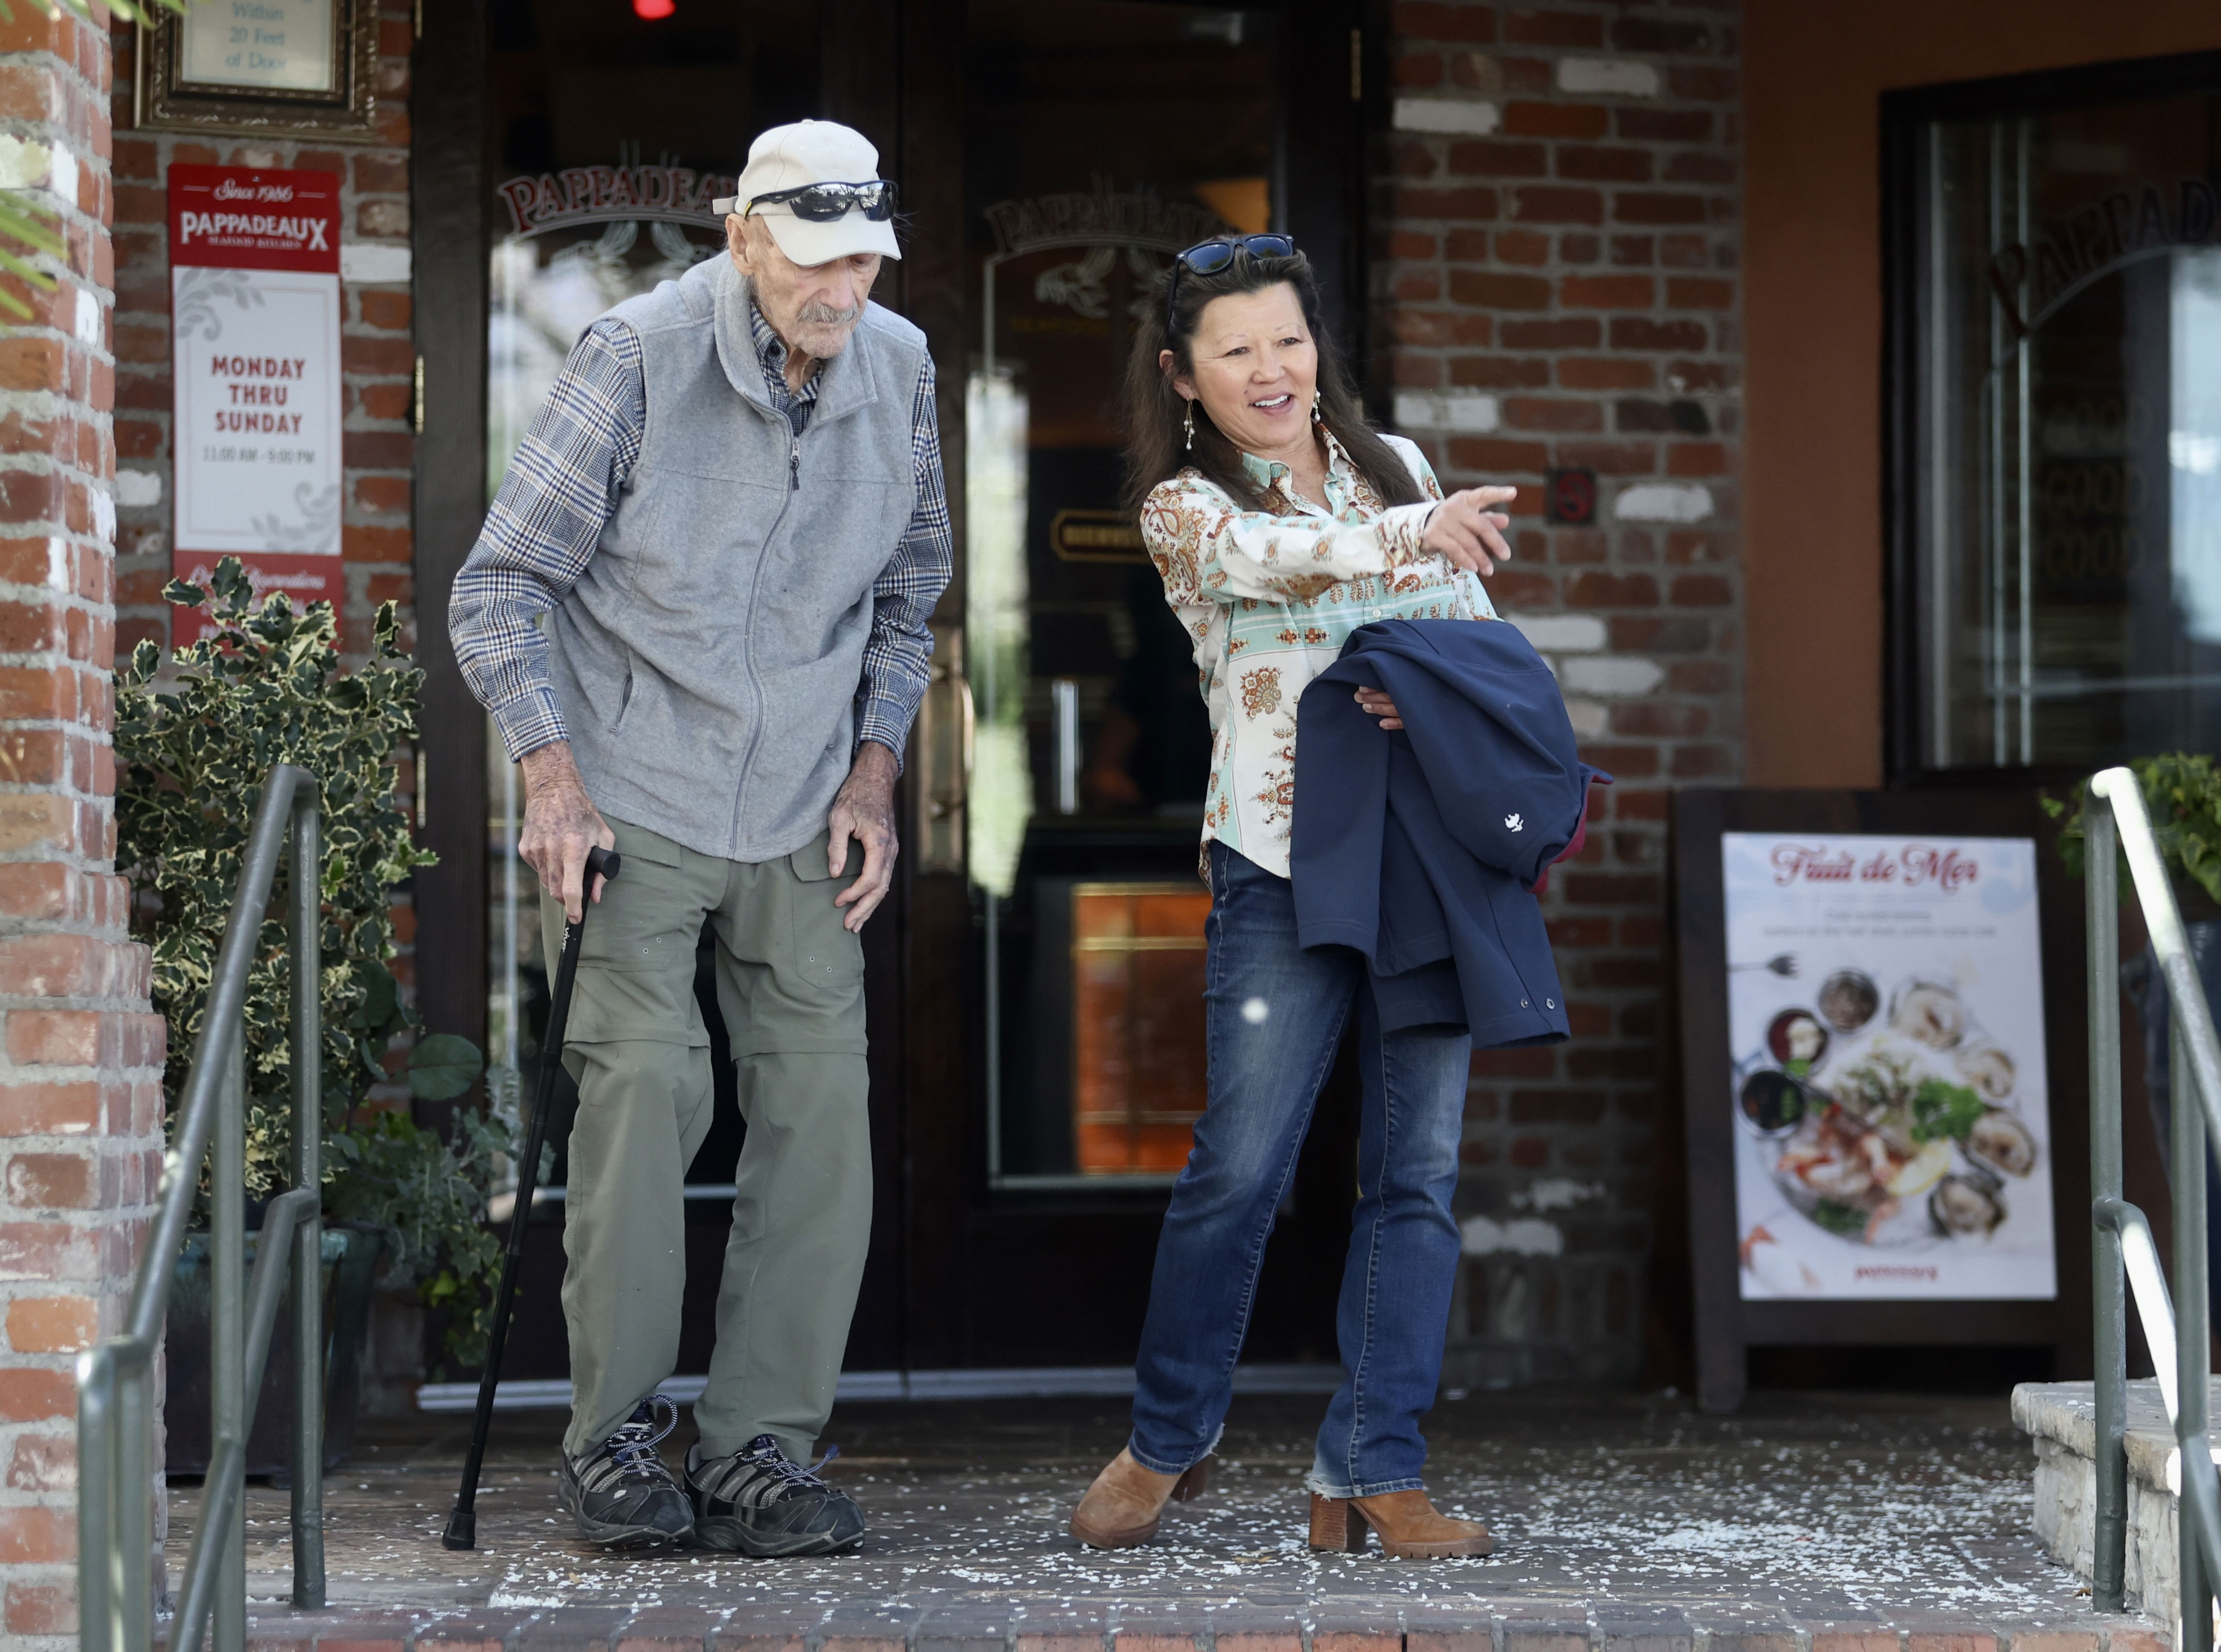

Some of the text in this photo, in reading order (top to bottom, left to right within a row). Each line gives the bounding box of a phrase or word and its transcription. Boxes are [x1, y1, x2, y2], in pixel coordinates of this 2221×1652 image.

[232, 1, 284, 21] Within
[229, 26, 285, 46] 20 Feet
[225, 51, 287, 69] of Door
[214, 178, 255, 201] Since
[498, 166, 738, 234] PAPPADEA
[180, 211, 329, 251] PAPPADEAUX
[1987, 177, 2221, 336] PAPPAD
[212, 355, 306, 380] MONDAY
[228, 383, 288, 406] THRU
[215, 410, 303, 434] SUNDAY
[239, 446, 259, 463] AM
[297, 448, 317, 465] PM
[1860, 848, 1896, 882] de
[1900, 843, 1979, 895] Mer
